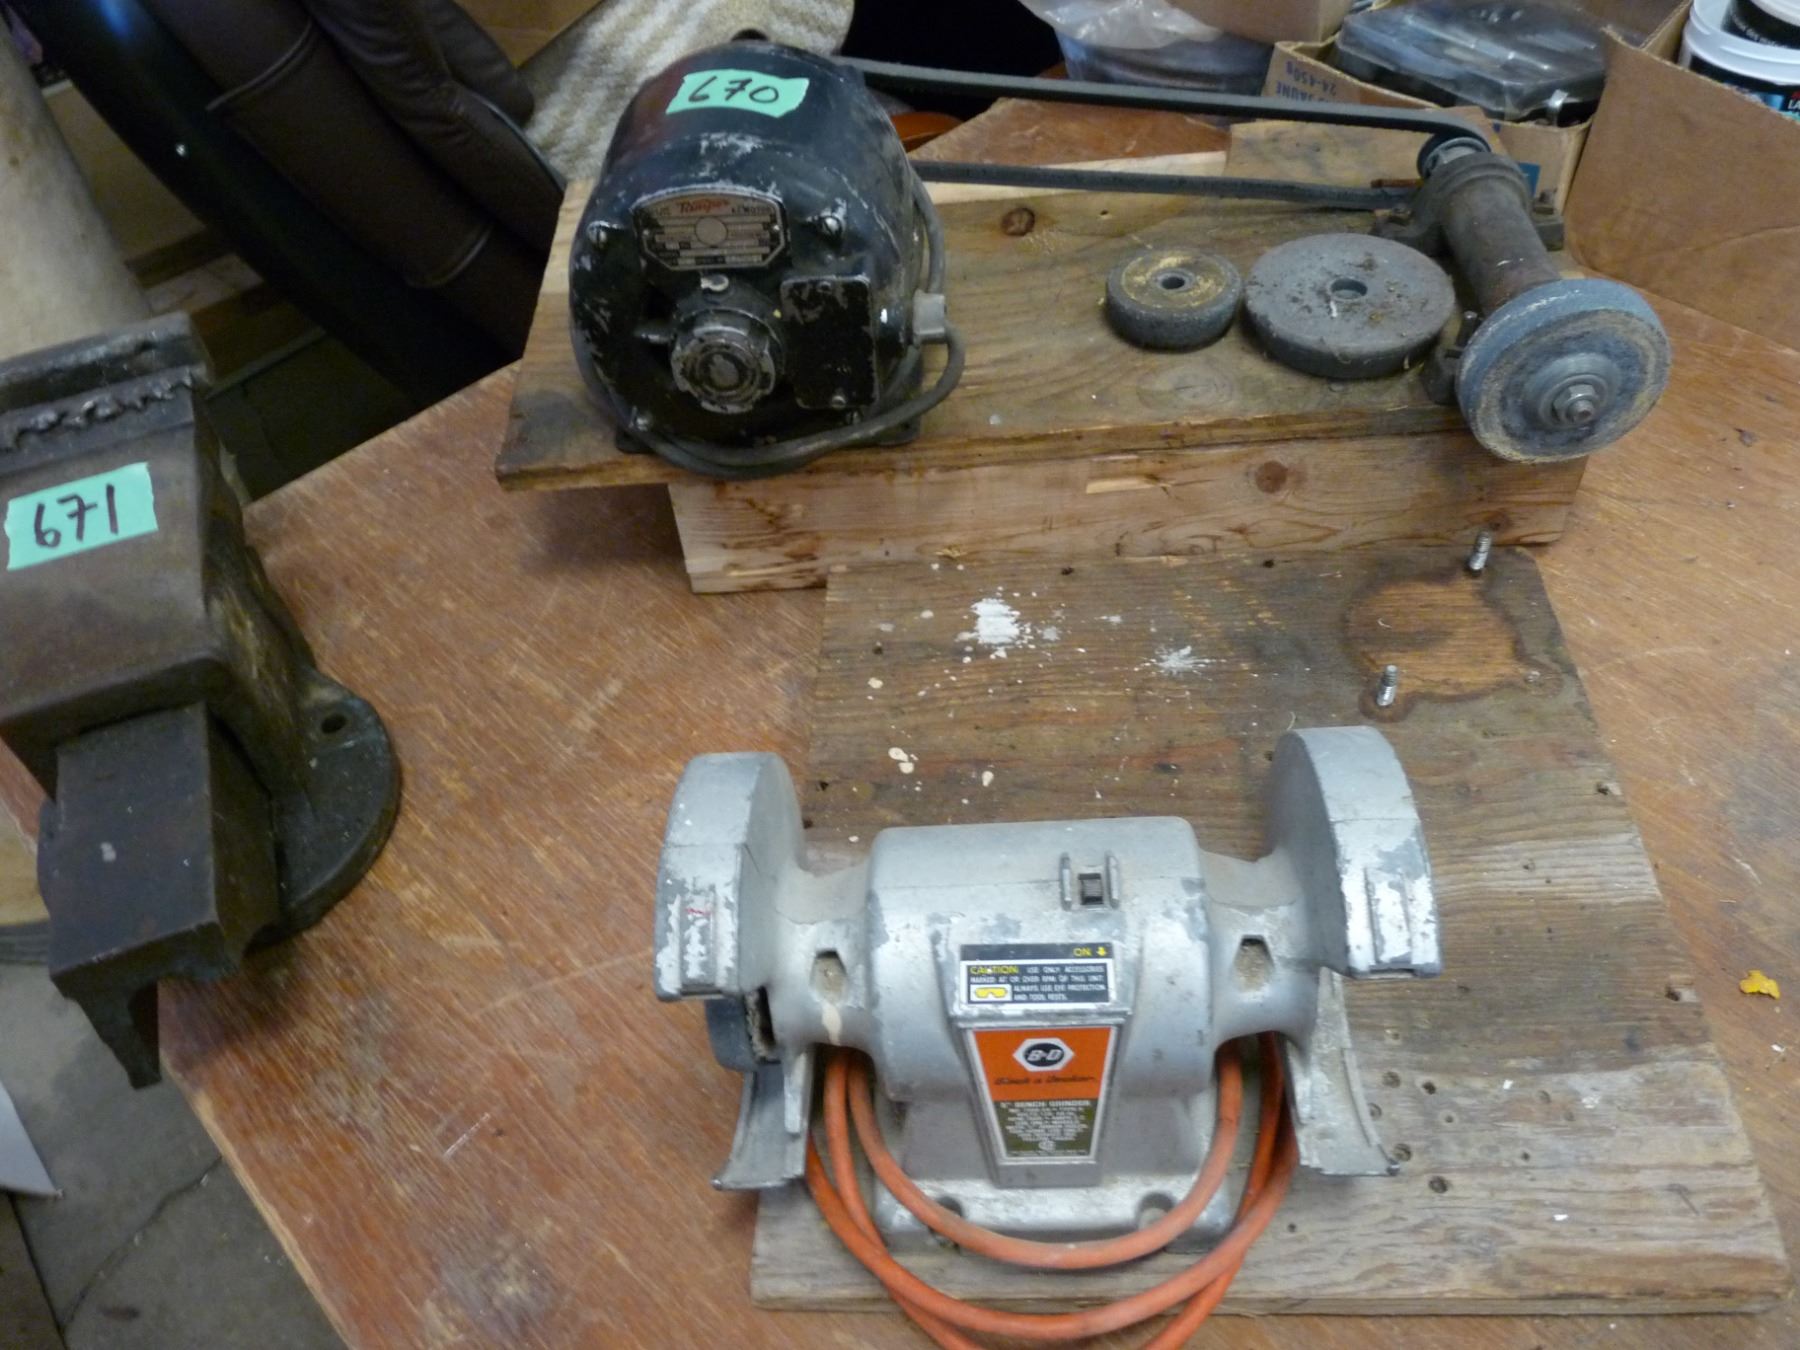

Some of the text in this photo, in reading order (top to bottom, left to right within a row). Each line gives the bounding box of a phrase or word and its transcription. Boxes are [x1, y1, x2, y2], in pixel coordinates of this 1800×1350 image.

[687, 75, 780, 104] 670
[34, 483, 119, 549] 671
[1073, 947, 1092, 957] ON
